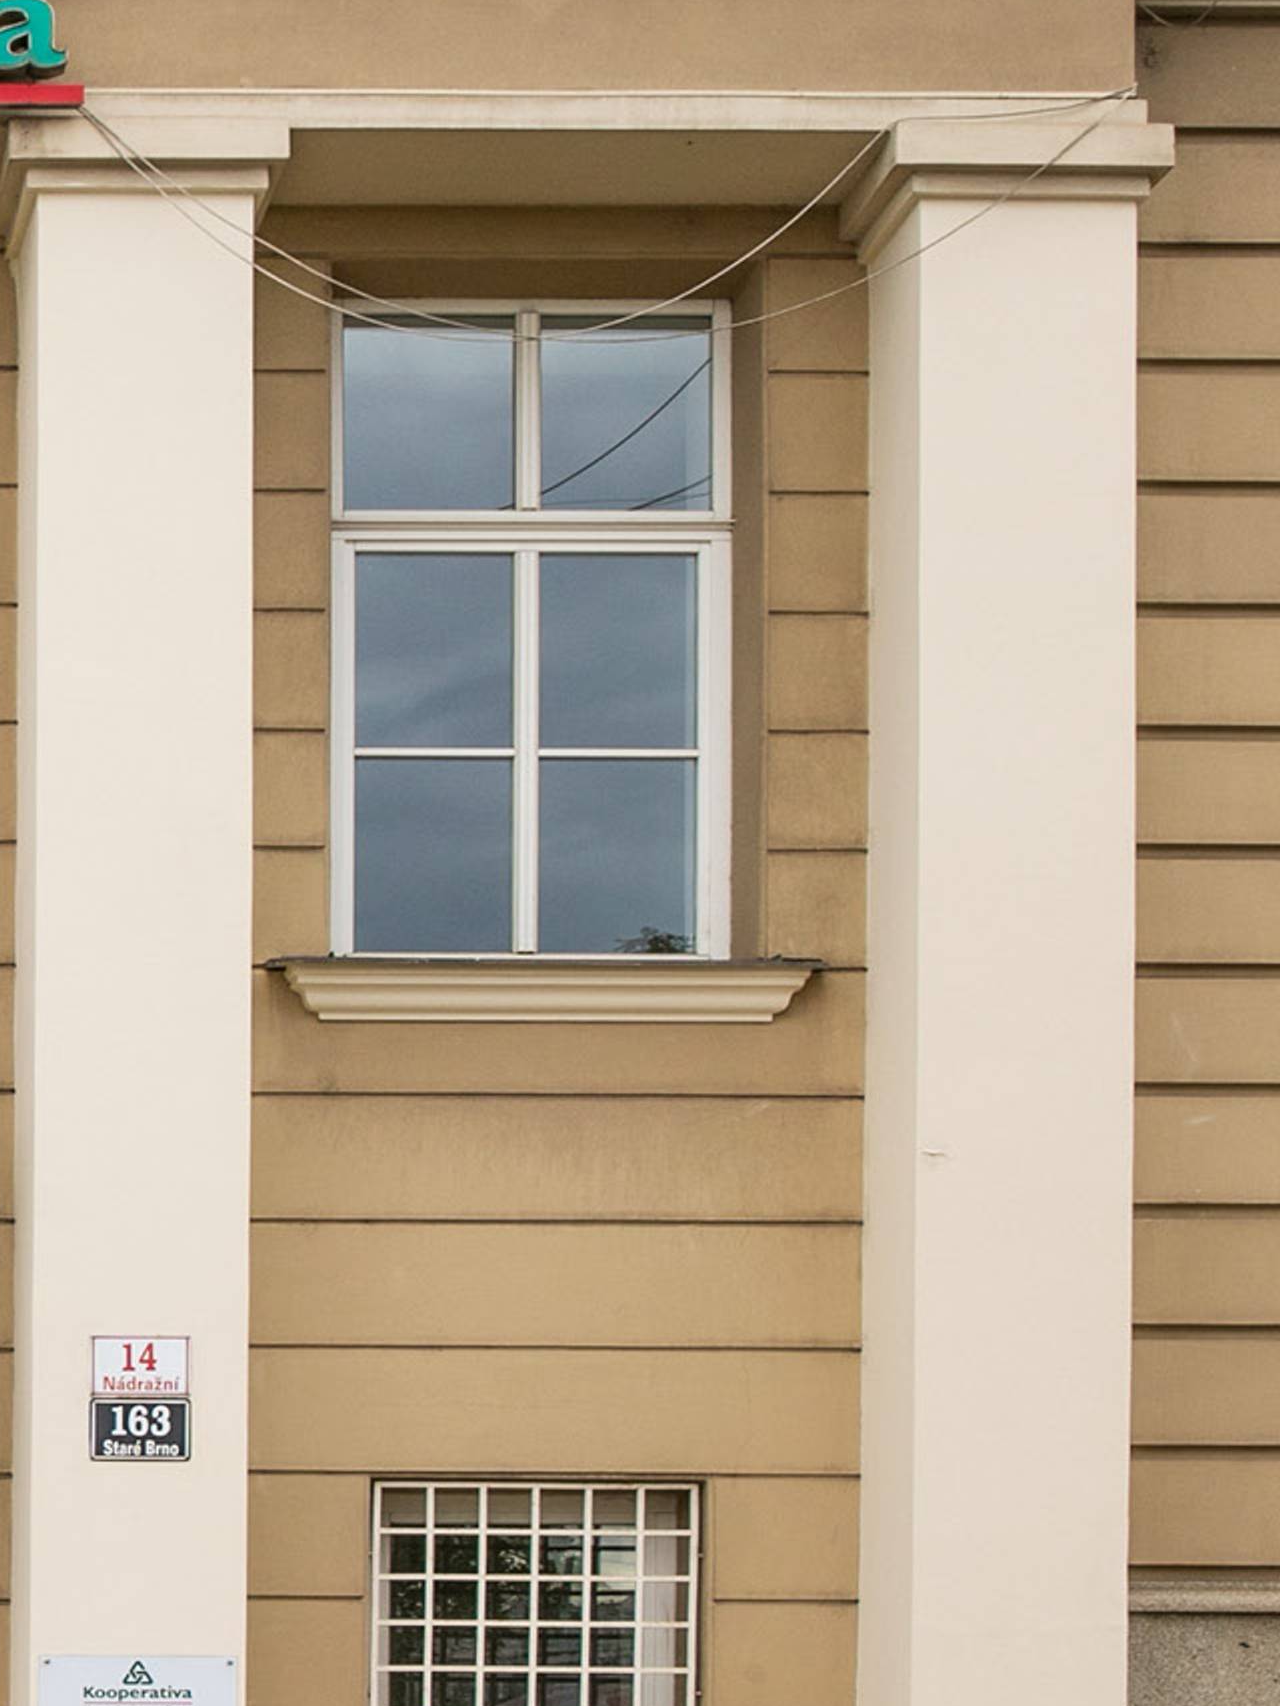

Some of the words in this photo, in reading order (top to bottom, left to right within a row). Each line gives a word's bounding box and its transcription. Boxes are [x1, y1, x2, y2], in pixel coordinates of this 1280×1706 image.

[122, 1342, 157, 1372] 14
[102, 1375, 181, 1392] Nádražní
[111, 1404, 172, 1437] 163
[103, 1439, 141, 1456] Staré
[145, 1439, 180, 1456] Brno
[82, 1685, 193, 1702] Kooperativa
